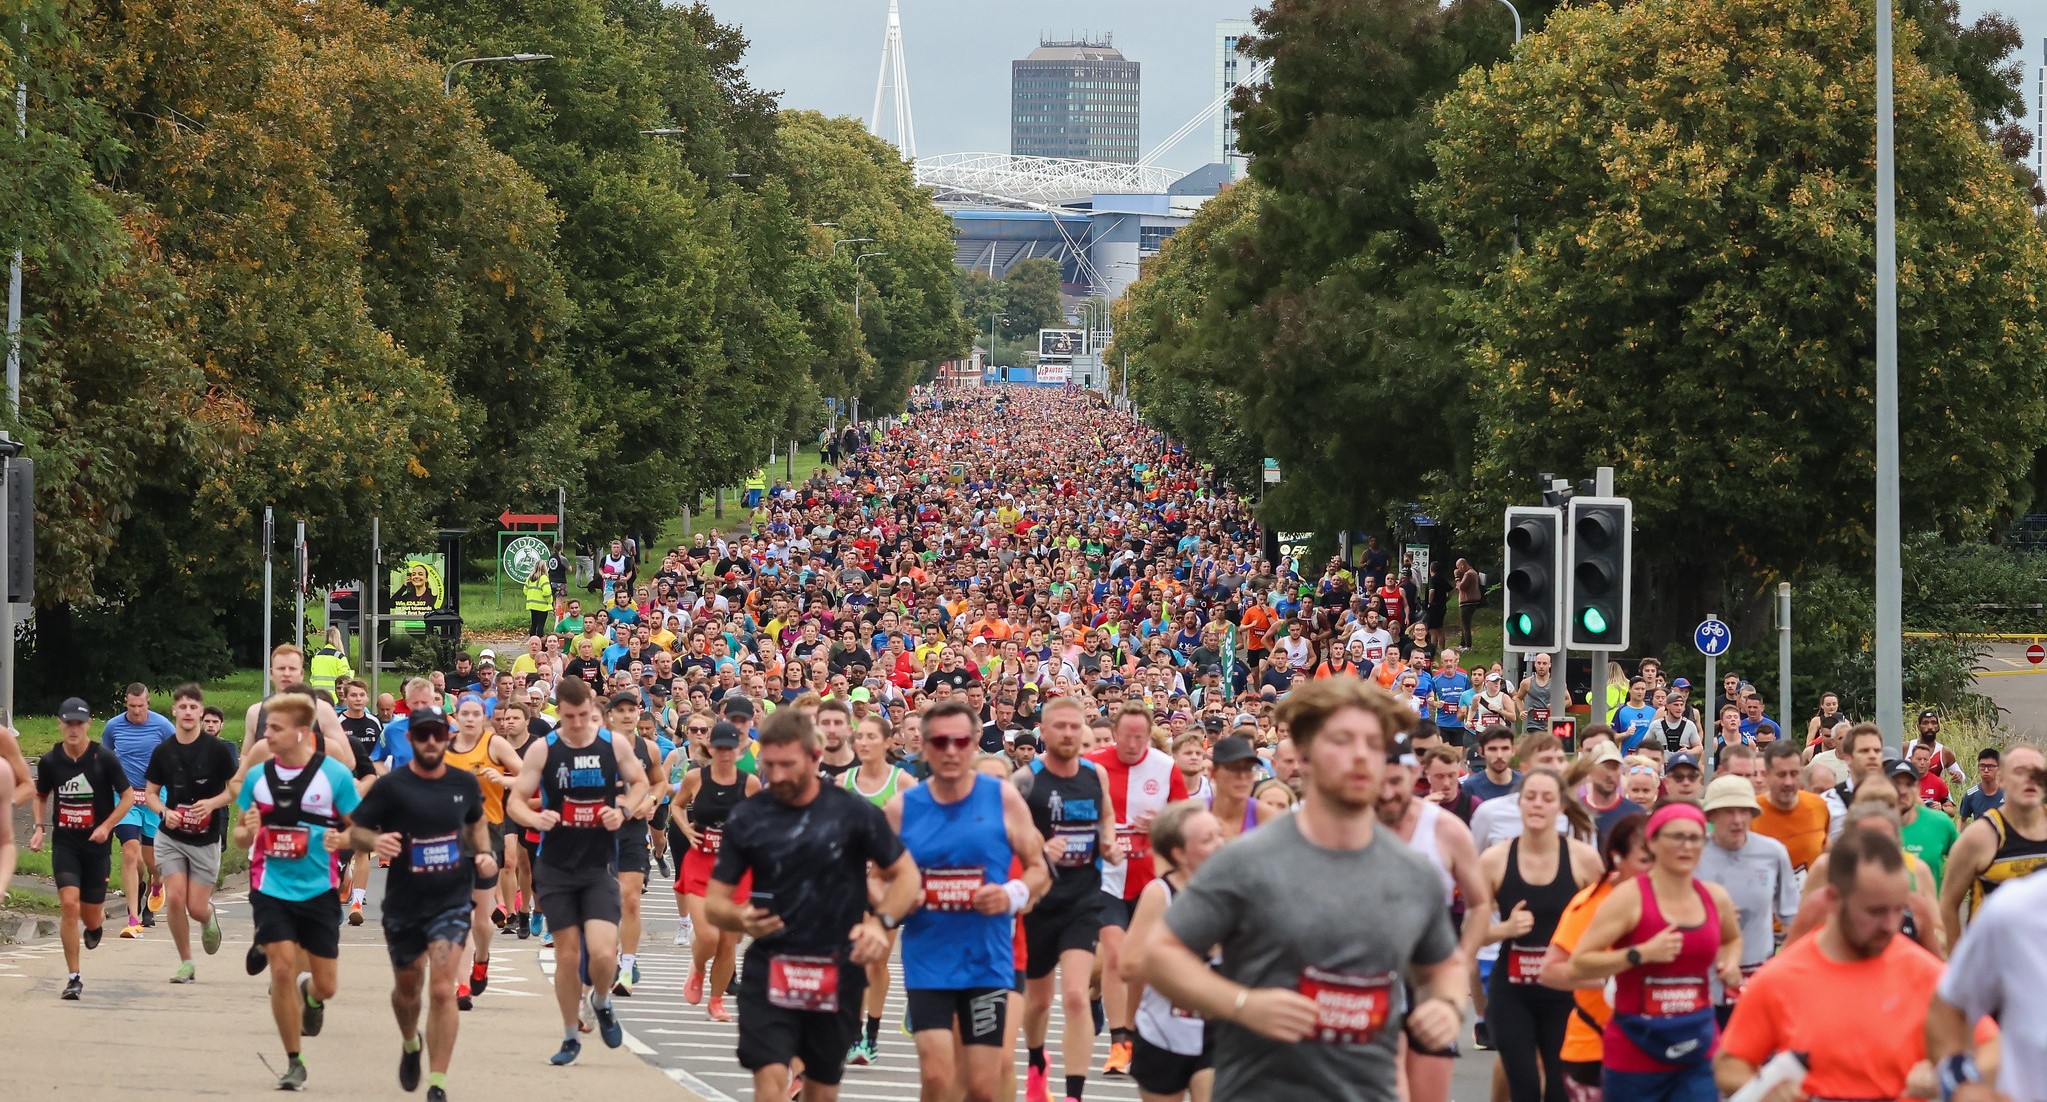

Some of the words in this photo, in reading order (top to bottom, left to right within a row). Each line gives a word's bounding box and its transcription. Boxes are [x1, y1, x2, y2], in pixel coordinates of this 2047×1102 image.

[508, 539, 546, 555] FIDDES
[574, 755, 601, 769] NICK
[423, 845, 449, 856] CRAIG
